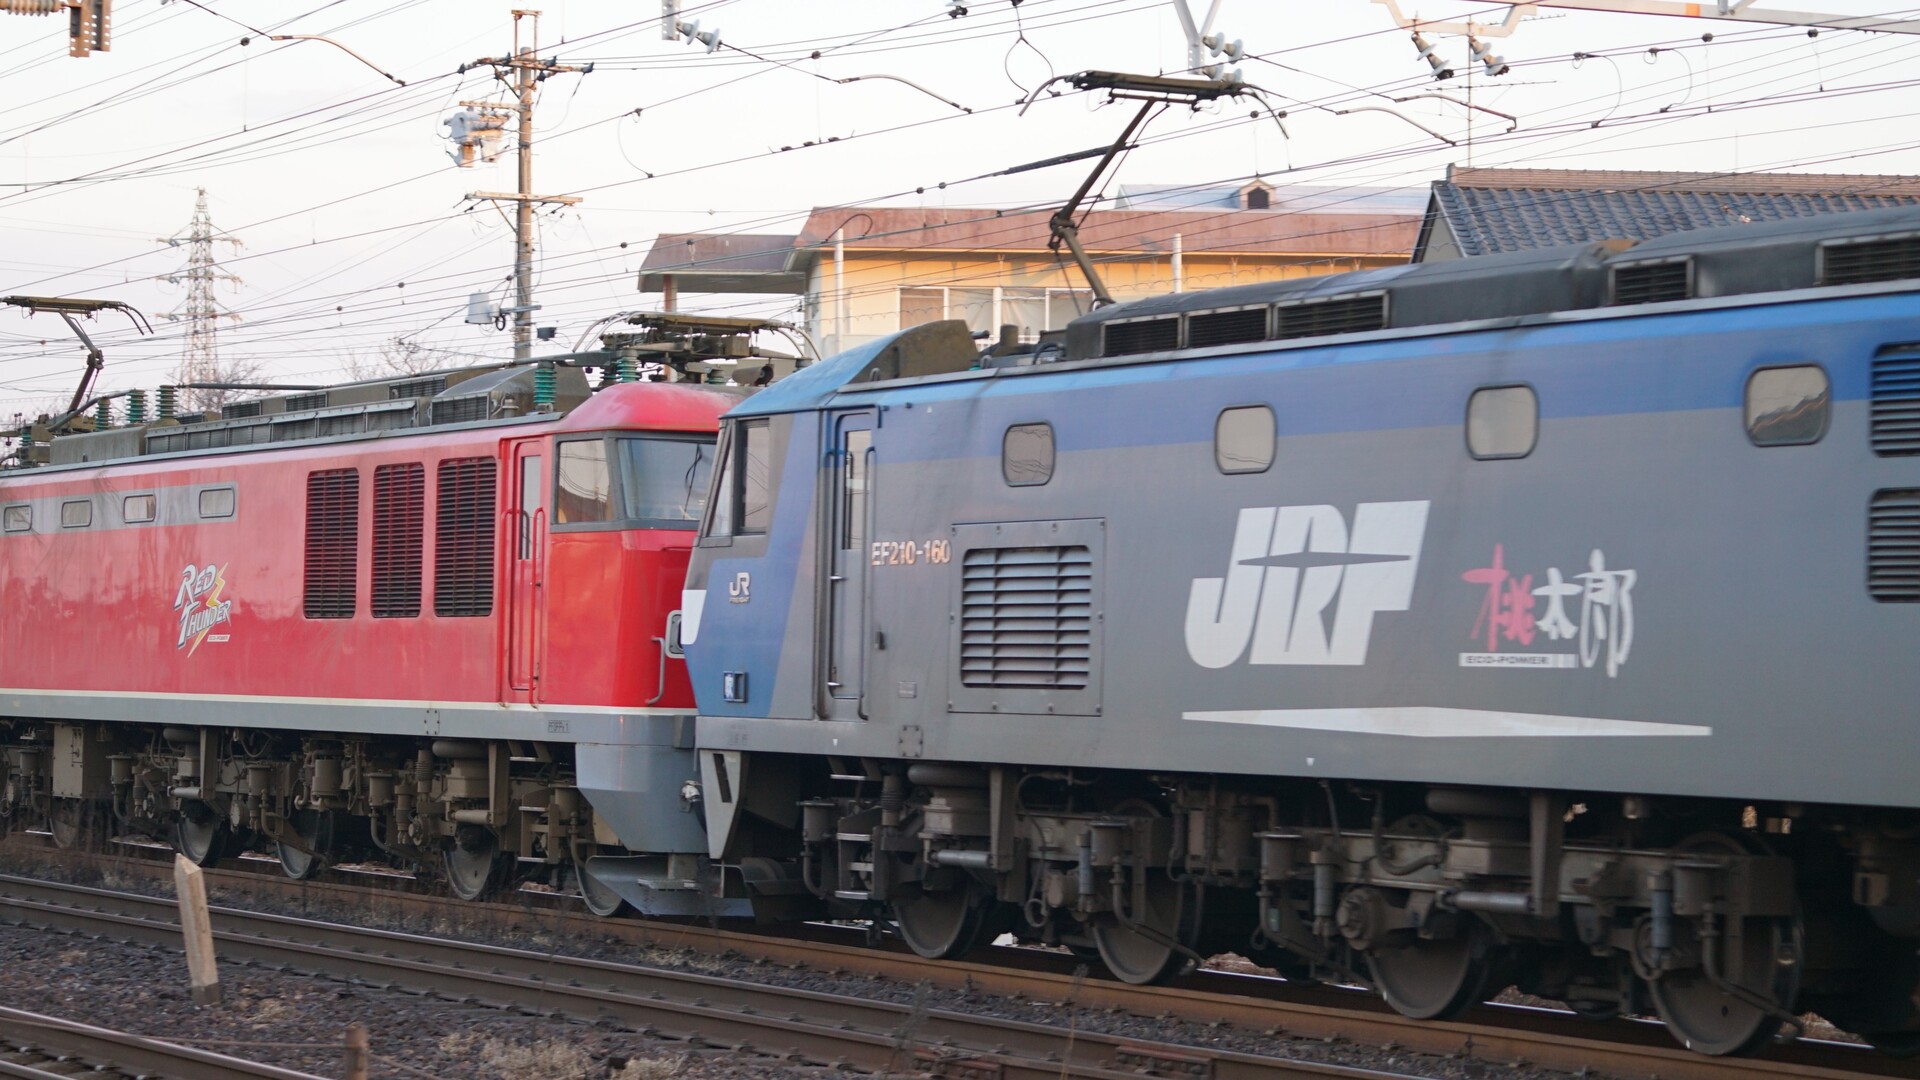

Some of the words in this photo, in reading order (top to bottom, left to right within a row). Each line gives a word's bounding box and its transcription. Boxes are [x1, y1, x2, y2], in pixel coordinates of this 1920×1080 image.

[871, 539, 952, 566] EF210-160
[173, 563, 218, 611] RED
[729, 572, 750, 596] JR
[1184, 500, 1431, 669] JRF
[177, 599, 231, 649] THUNDER
[1461, 543, 1637, 678] 桃太郎
